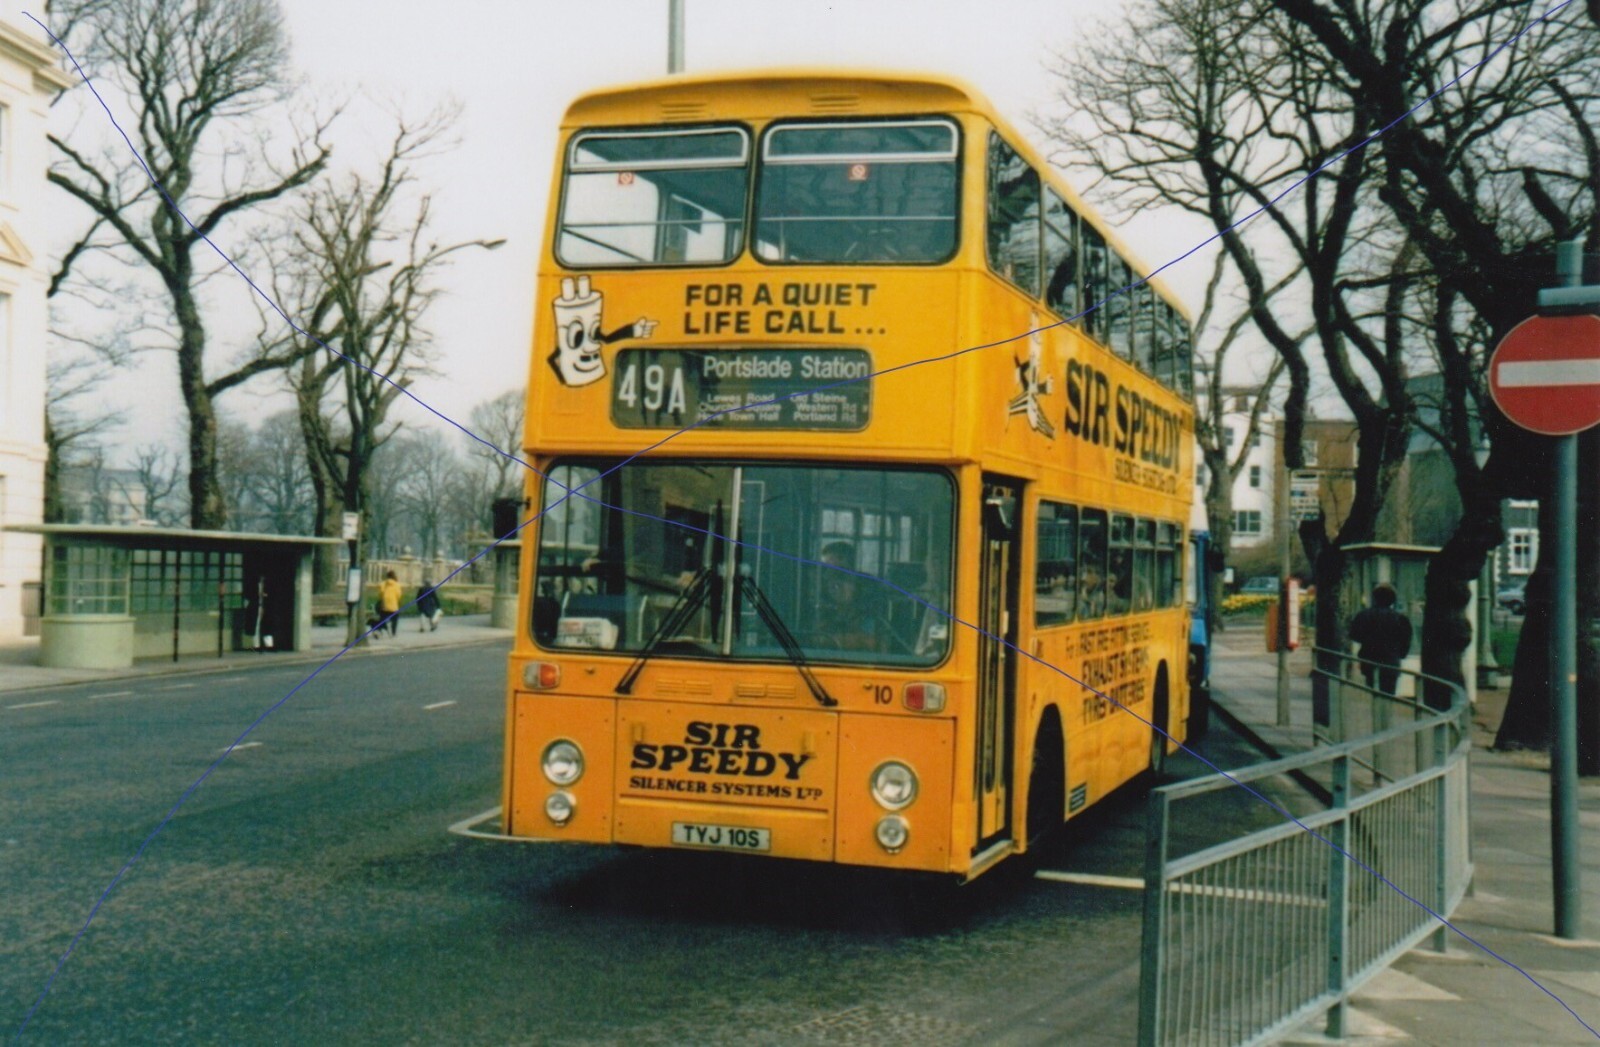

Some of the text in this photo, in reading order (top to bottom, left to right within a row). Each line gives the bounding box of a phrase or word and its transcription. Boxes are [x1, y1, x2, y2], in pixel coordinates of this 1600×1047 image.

[685, 283, 877, 308] FOR A QUIET
[684, 311, 751, 335] LIFE
[702, 355, 869, 379] Portslade Station
[617, 364, 687, 416] 49A
[1064, 357, 1184, 474] SIR SPEEDY
[874, 684, 893, 705] 10
[684, 720, 761, 750] SIR
[630, 743, 810, 780] SPEEDY
[629, 775, 707, 794] SILENCER
[711, 781, 791, 799] SYSTEMS
[683, 825, 760, 848] TYJ 10S
